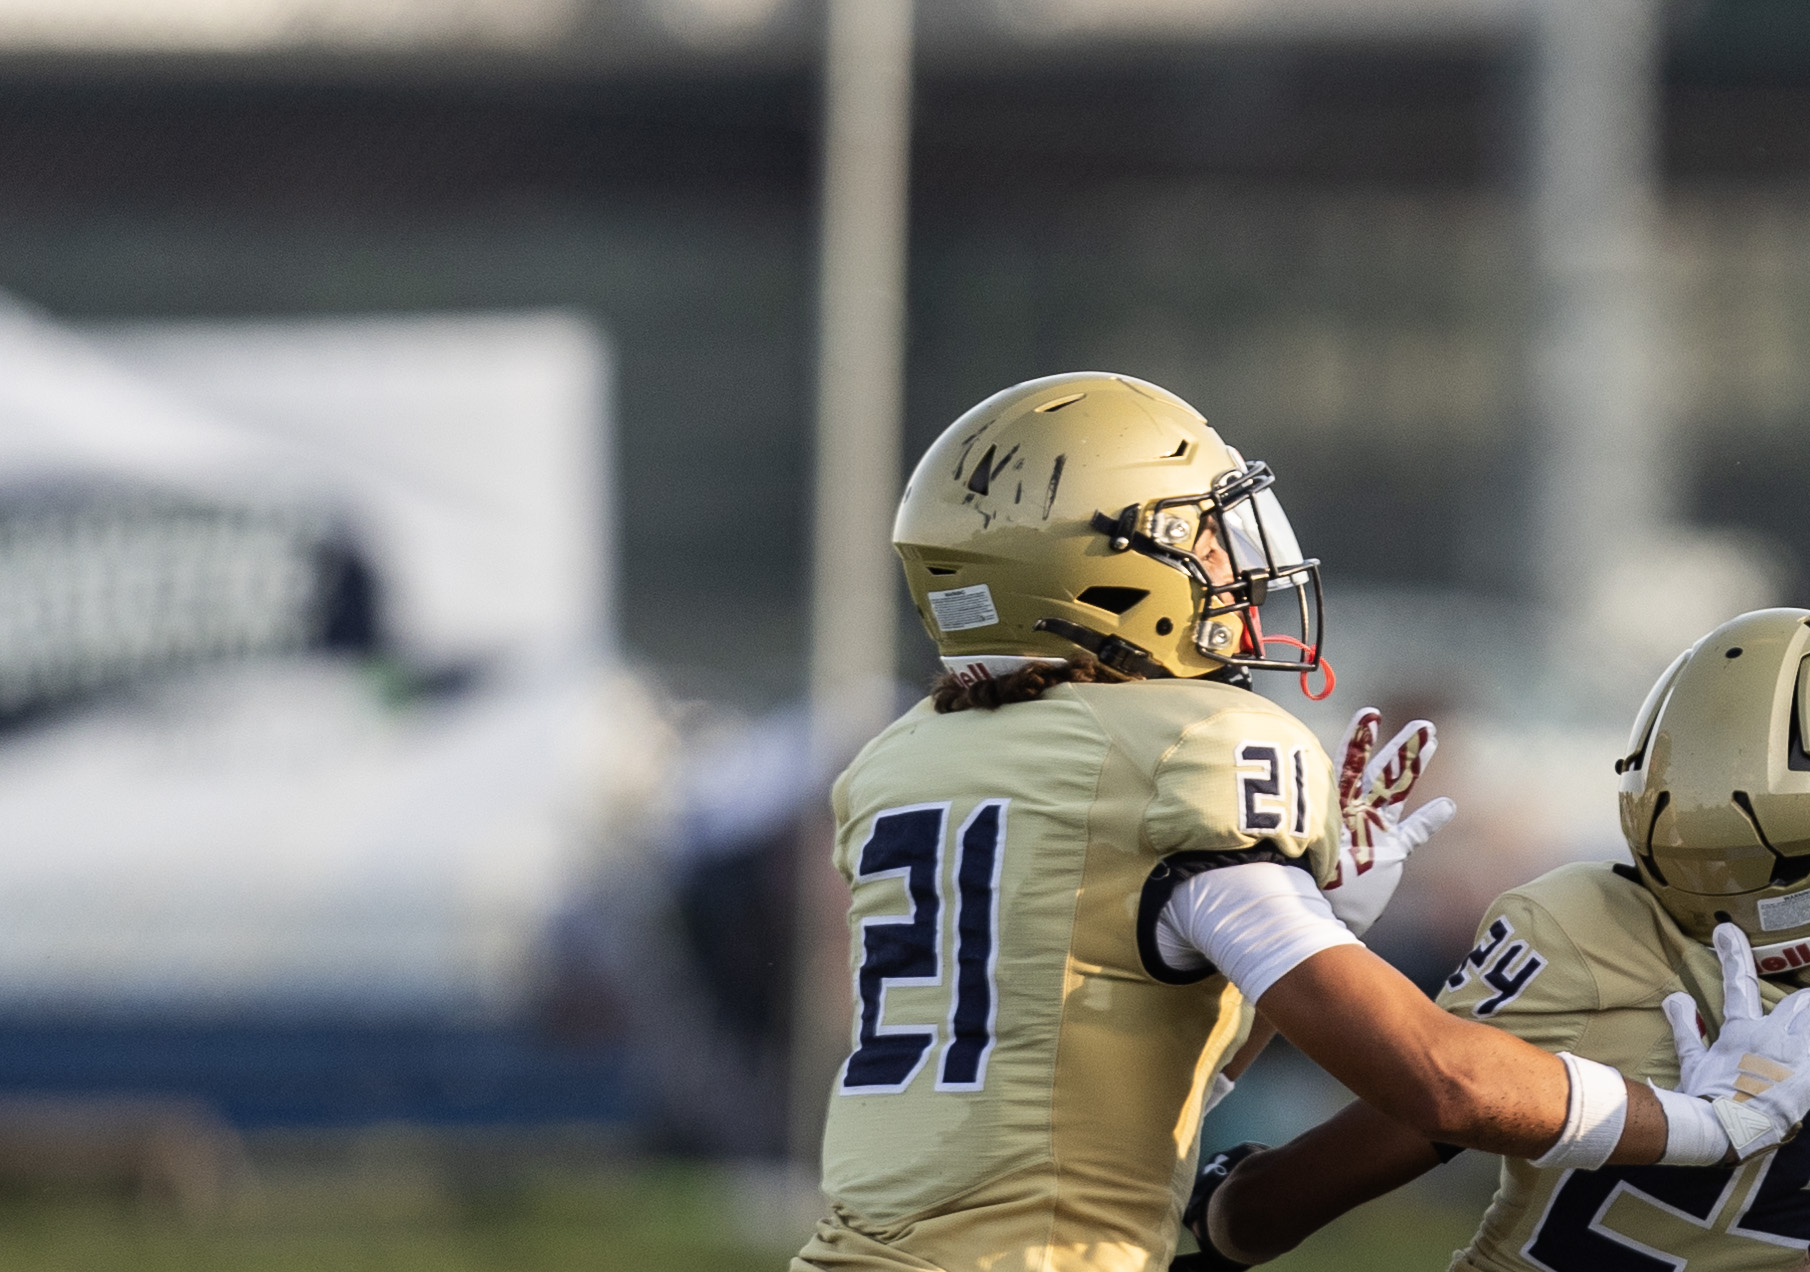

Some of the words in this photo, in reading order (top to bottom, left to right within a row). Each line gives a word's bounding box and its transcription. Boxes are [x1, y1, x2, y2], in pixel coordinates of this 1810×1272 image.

[1234, 739, 1310, 838] 21
[841, 798, 1010, 1095] 21
[1447, 914, 1549, 1019] 24
